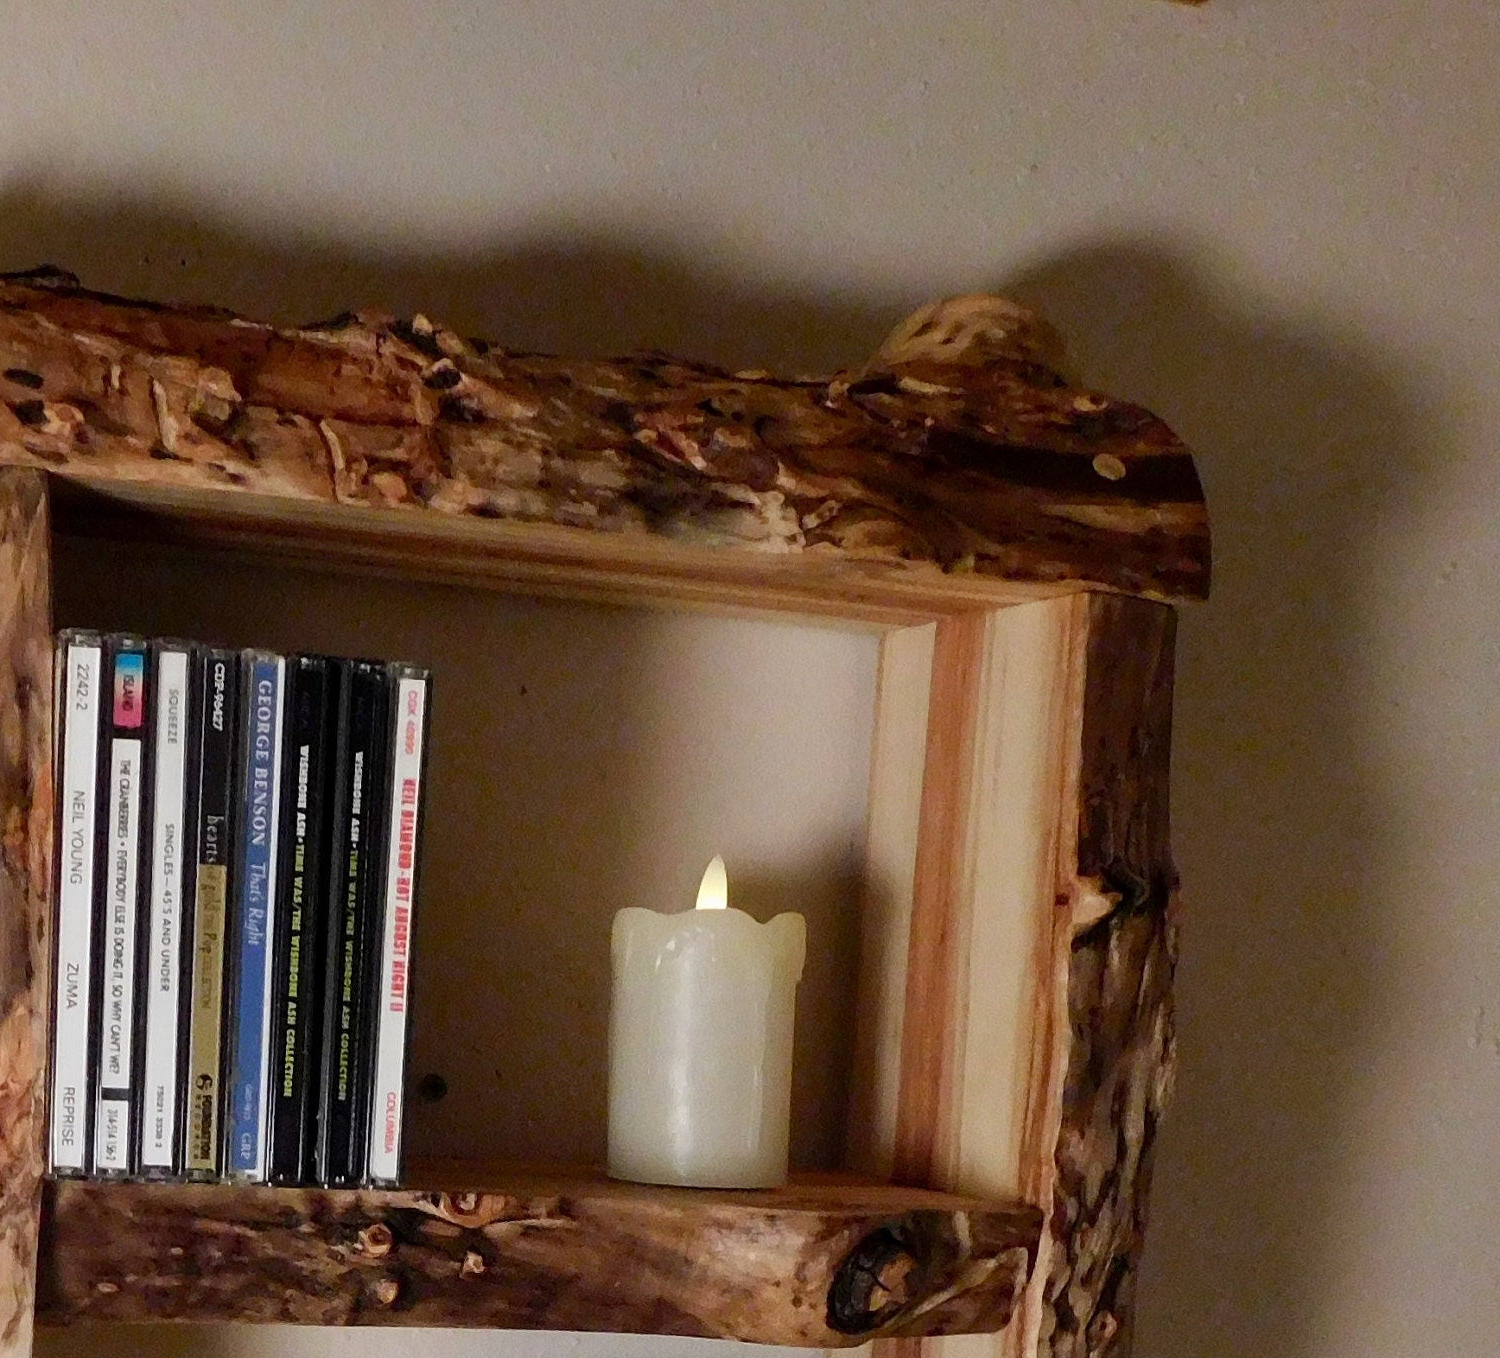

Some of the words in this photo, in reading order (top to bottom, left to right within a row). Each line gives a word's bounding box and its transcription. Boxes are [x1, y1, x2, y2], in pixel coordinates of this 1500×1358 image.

[76, 664, 89, 710] 2242-2
[122, 675, 134, 710] ISLAND
[212, 663, 225, 731] CDP-96427
[167, 689, 179, 744] SQUEEZE
[256, 680, 272, 761] GEORGE
[119, 760, 131, 776] THE
[297, 745, 309, 808] WISHBONE
[352, 752, 364, 814] WISHBONE
[72, 791, 85, 823] NEIL
[118, 778, 130, 839] CRANBERRIES
[251, 768, 268, 845] BENSON
[402, 778, 416, 804] NEIL
[206, 815, 224, 862] hearts
[296, 812, 305, 836] ASH
[351, 818, 360, 841] ASH
[70, 828, 83, 884] YOUNG
[295, 845, 304, 871] TIME
[349, 850, 358, 876] TIME
[115, 850, 128, 903] EVERYBODY
[249, 863, 265, 902] That's
[115, 906, 125, 924] ELSE
[201, 884, 222, 912] gold
[114, 927, 124, 935] IS
[161, 918, 172, 945] AND
[200, 933, 217, 954] Pop
[244, 908, 262, 945] Right
[393, 906, 408, 956] AUGUST
[113, 938, 124, 969] DOING
[160, 950, 171, 991] UNDER
[288, 936, 300, 997] WISHBONE
[342, 941, 354, 1001] WISHBONE
[66, 963, 79, 1008] ZUMA
[112, 985, 121, 998] SO
[391, 961, 405, 998] NIGHT
[111, 1000, 121, 1021] WHY
[287, 1002, 297, 1025] ASH
[341, 1006, 351, 1029] ASH
[390, 1003, 403, 1012] II
[110, 1025, 120, 1052] CAN'T
[109, 1055, 119, 1074] WE?
[283, 1029, 296, 1097] COLLECTION
[338, 1033, 349, 1101] COLLECTION
[62, 1088, 75, 1146] REPRISE
[200, 1095, 212, 1159] FOUNDATION
[384, 1092, 396, 1154] COLUMBIA
[240, 1133, 250, 1159] GRP
